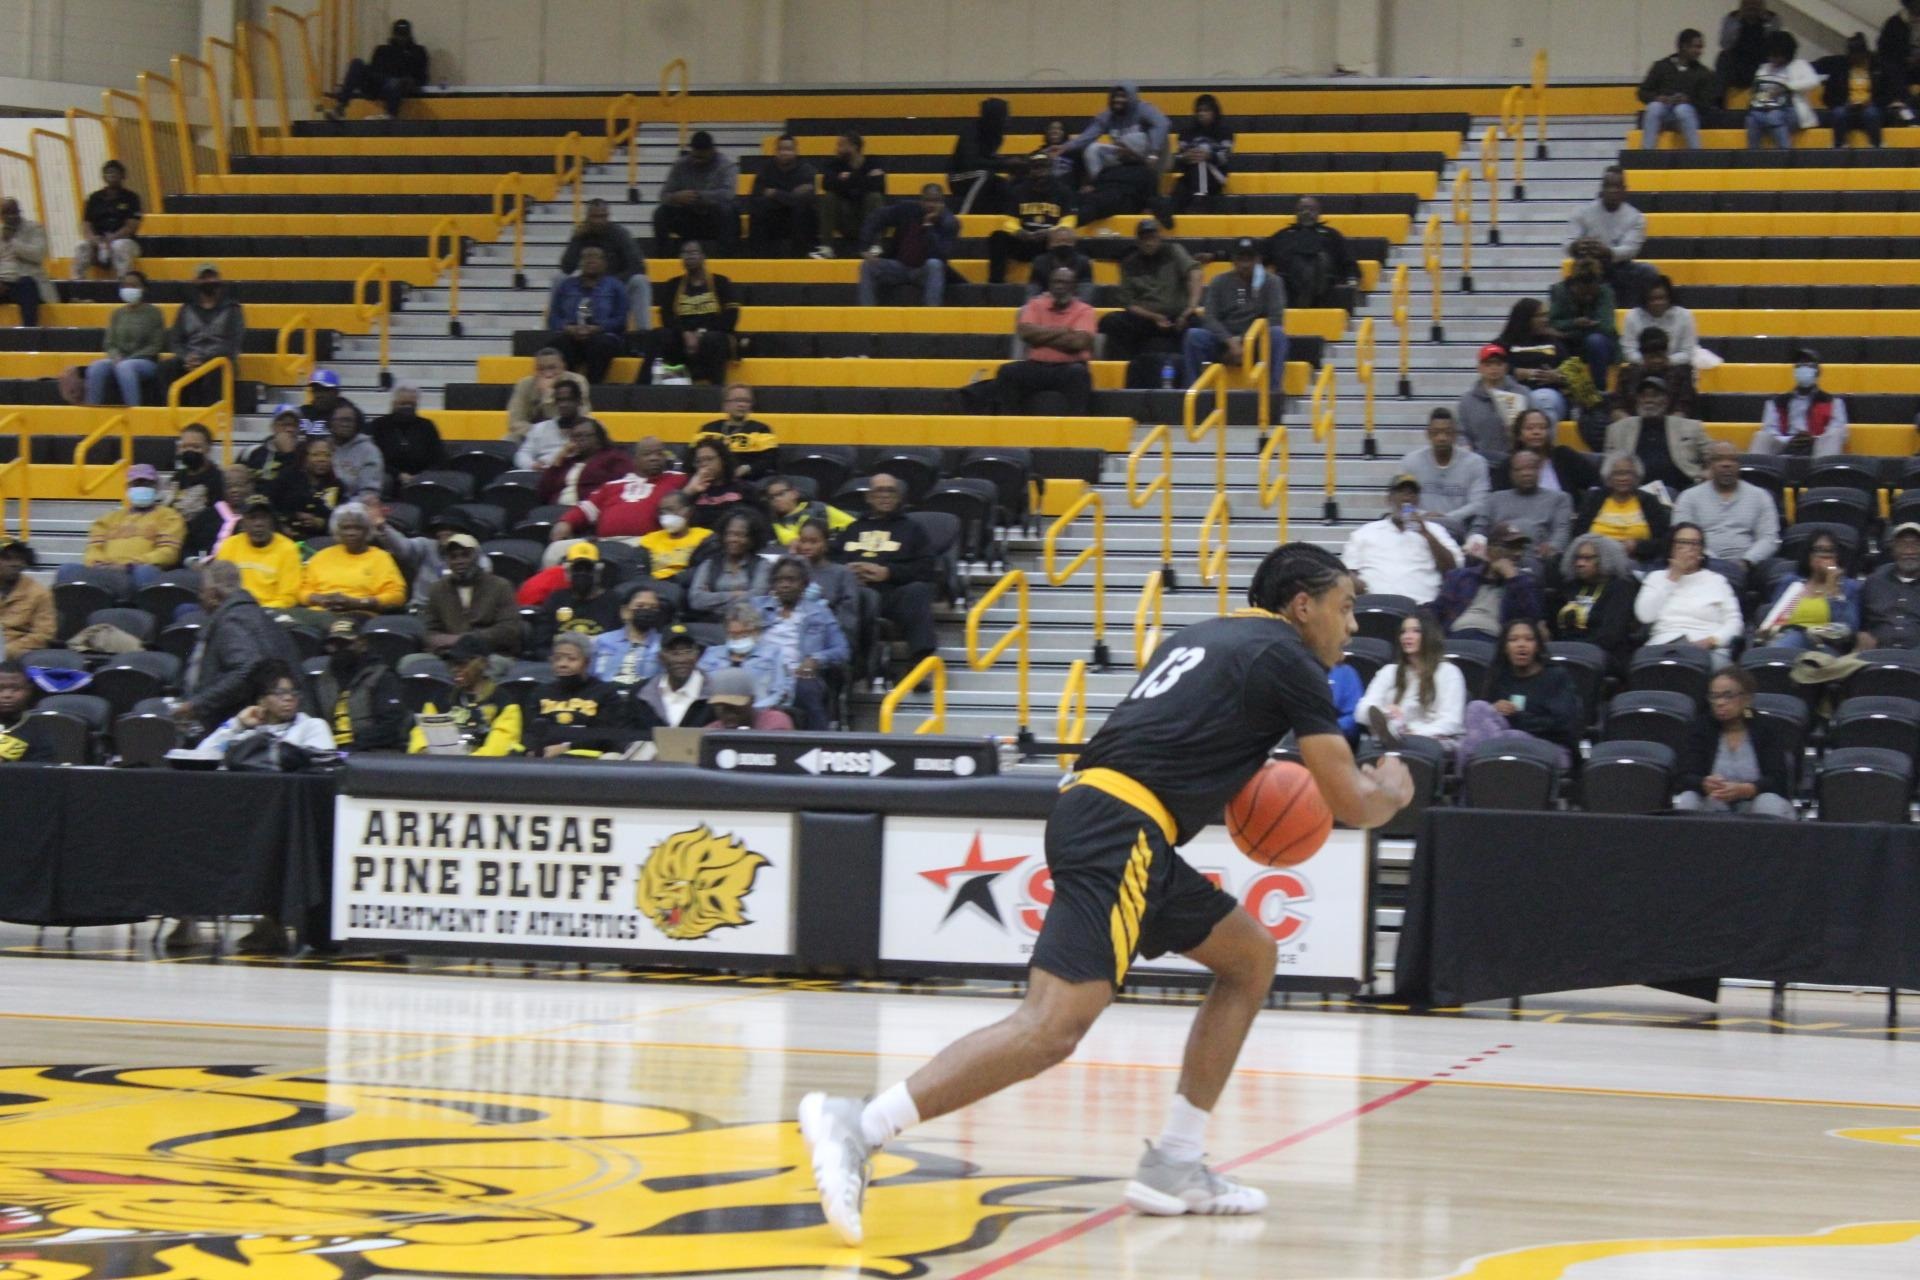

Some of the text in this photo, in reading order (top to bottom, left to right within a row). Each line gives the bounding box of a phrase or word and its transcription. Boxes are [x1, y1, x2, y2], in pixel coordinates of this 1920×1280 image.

[1130, 646, 1206, 699] 13
[819, 751, 872, 773] POSS
[362, 809, 614, 854] ARKANSAS
[351, 855, 622, 901] PINE BLUFF
[347, 903, 638, 939] DEPARTMENT OF ATHLETICS
